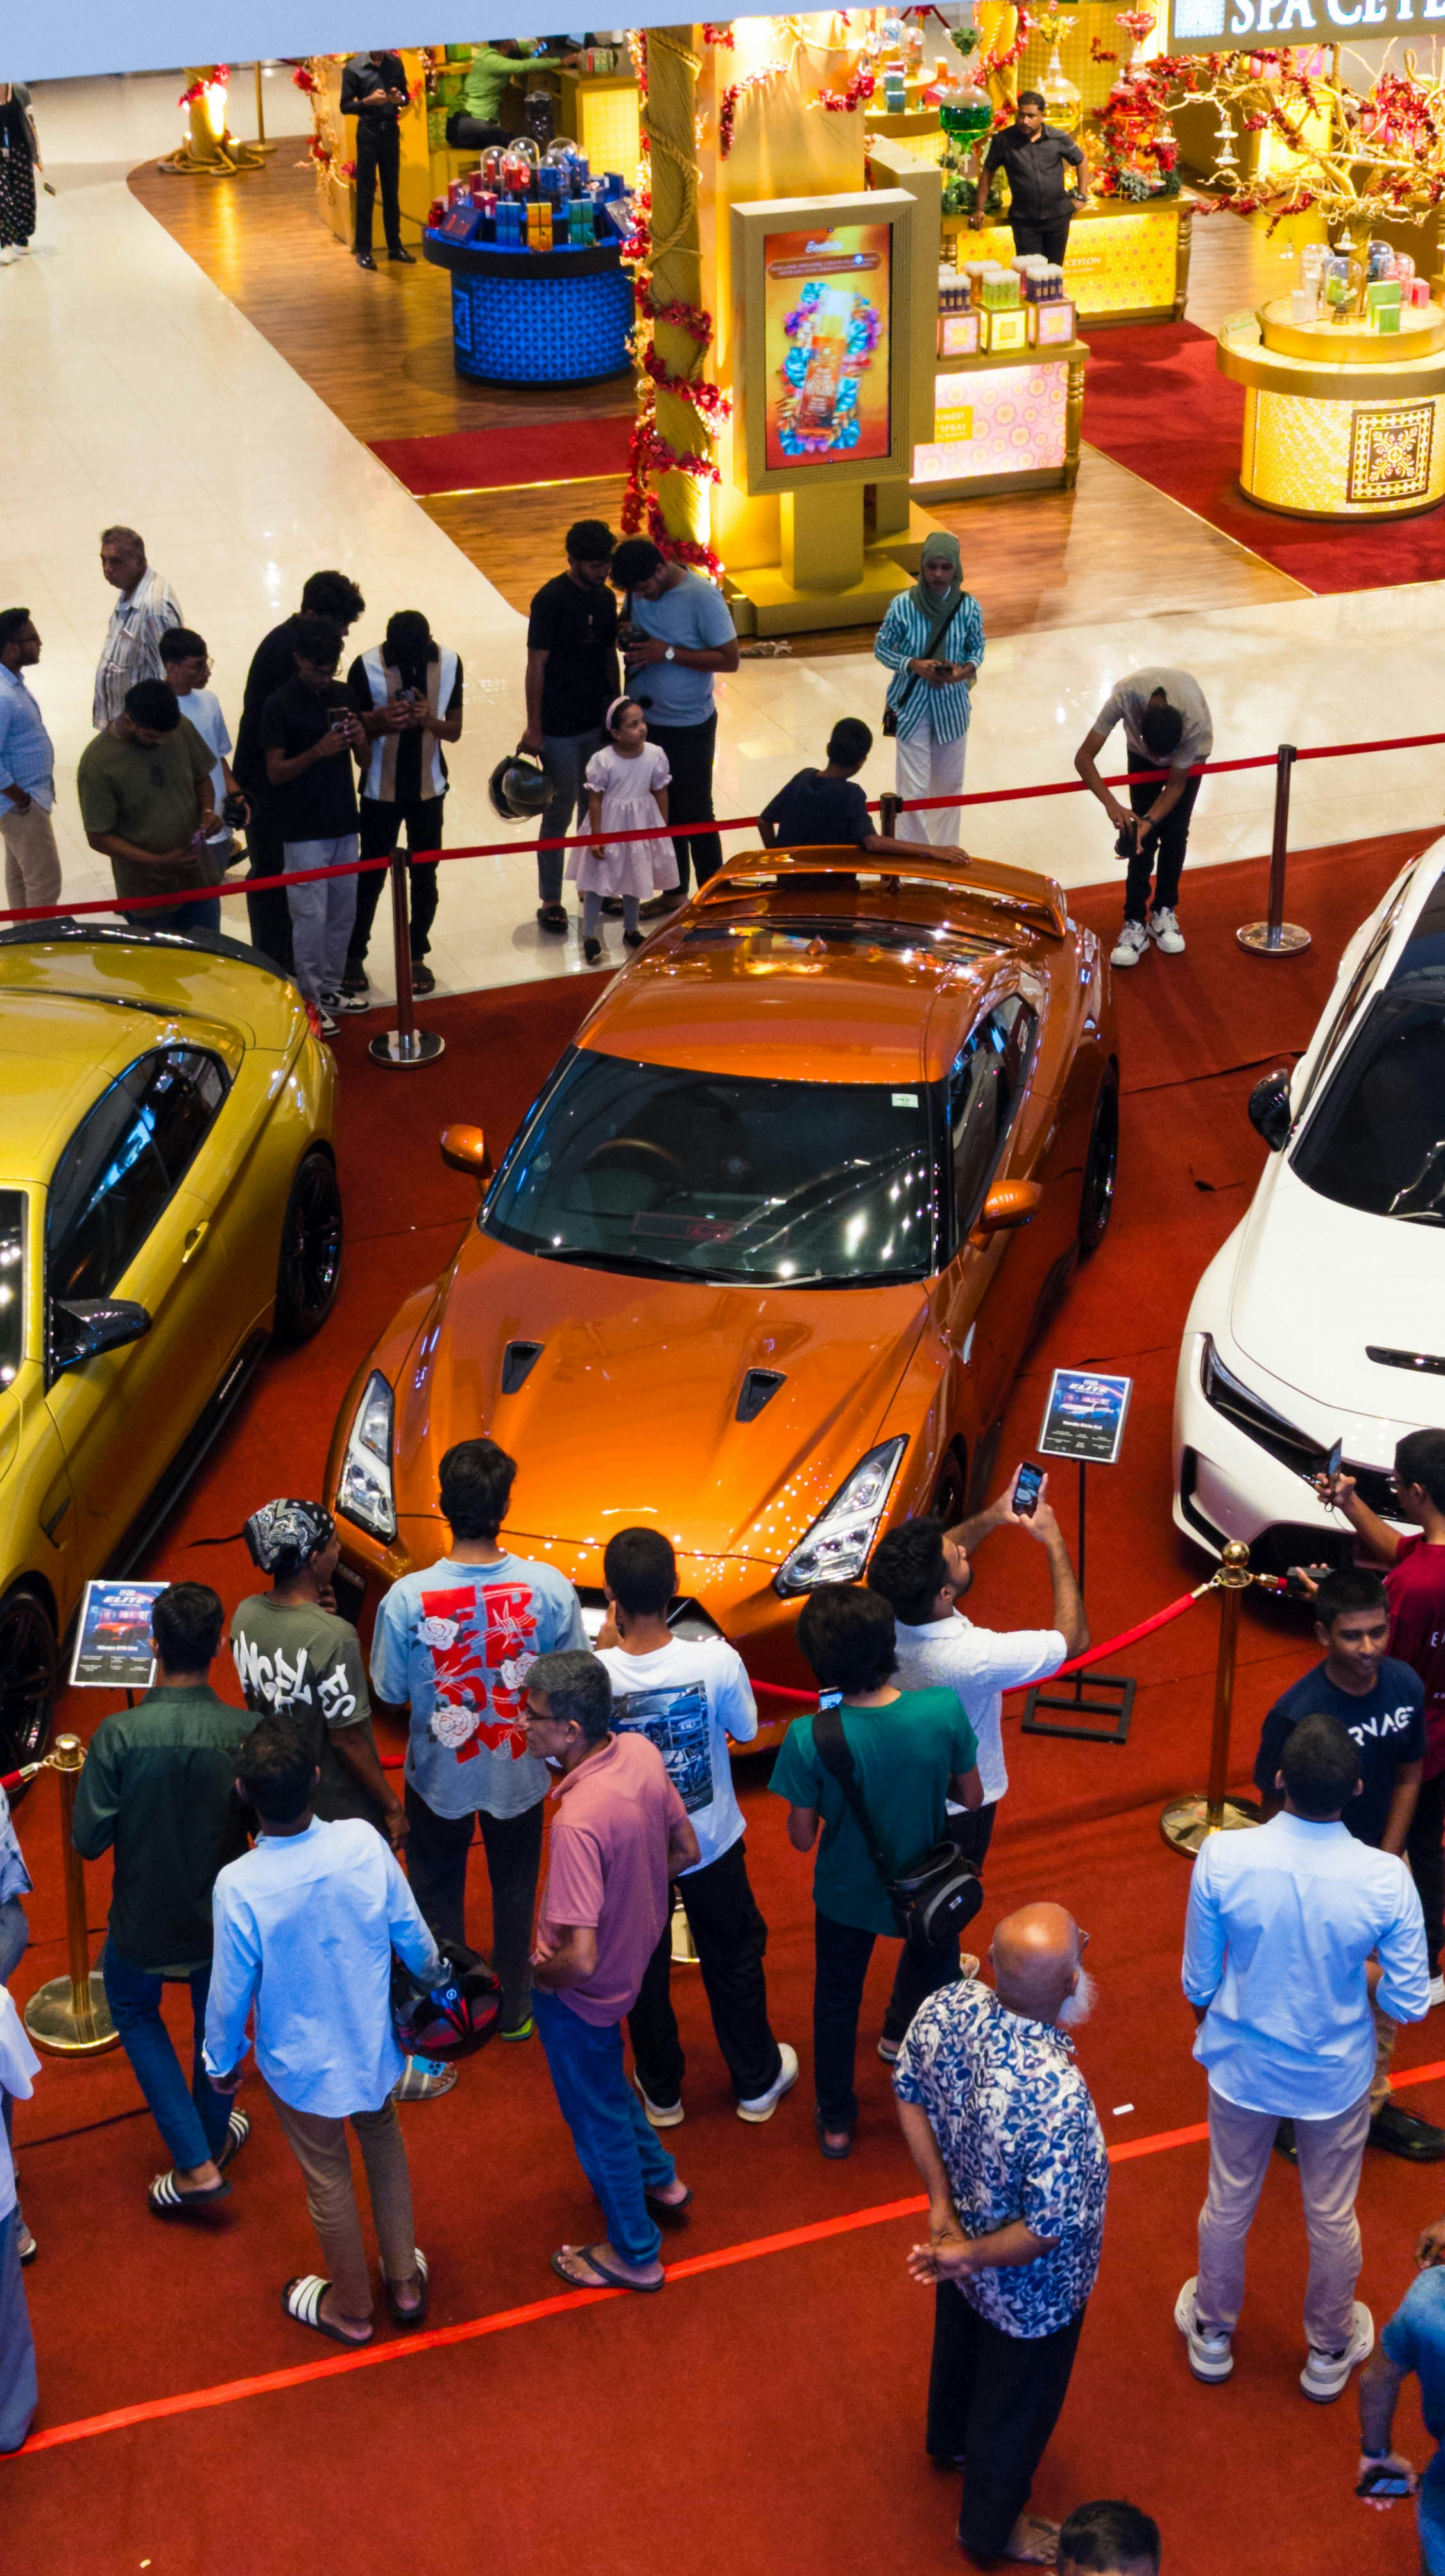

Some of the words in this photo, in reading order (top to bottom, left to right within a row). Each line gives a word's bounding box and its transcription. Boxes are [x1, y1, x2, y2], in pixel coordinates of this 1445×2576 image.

[1231, 0, 1317, 34] SPA
[1065, 257, 1102, 267] CEYLON
[937, 411, 964, 421] UMED
[1068, 1383, 1109, 1394] ELITE
